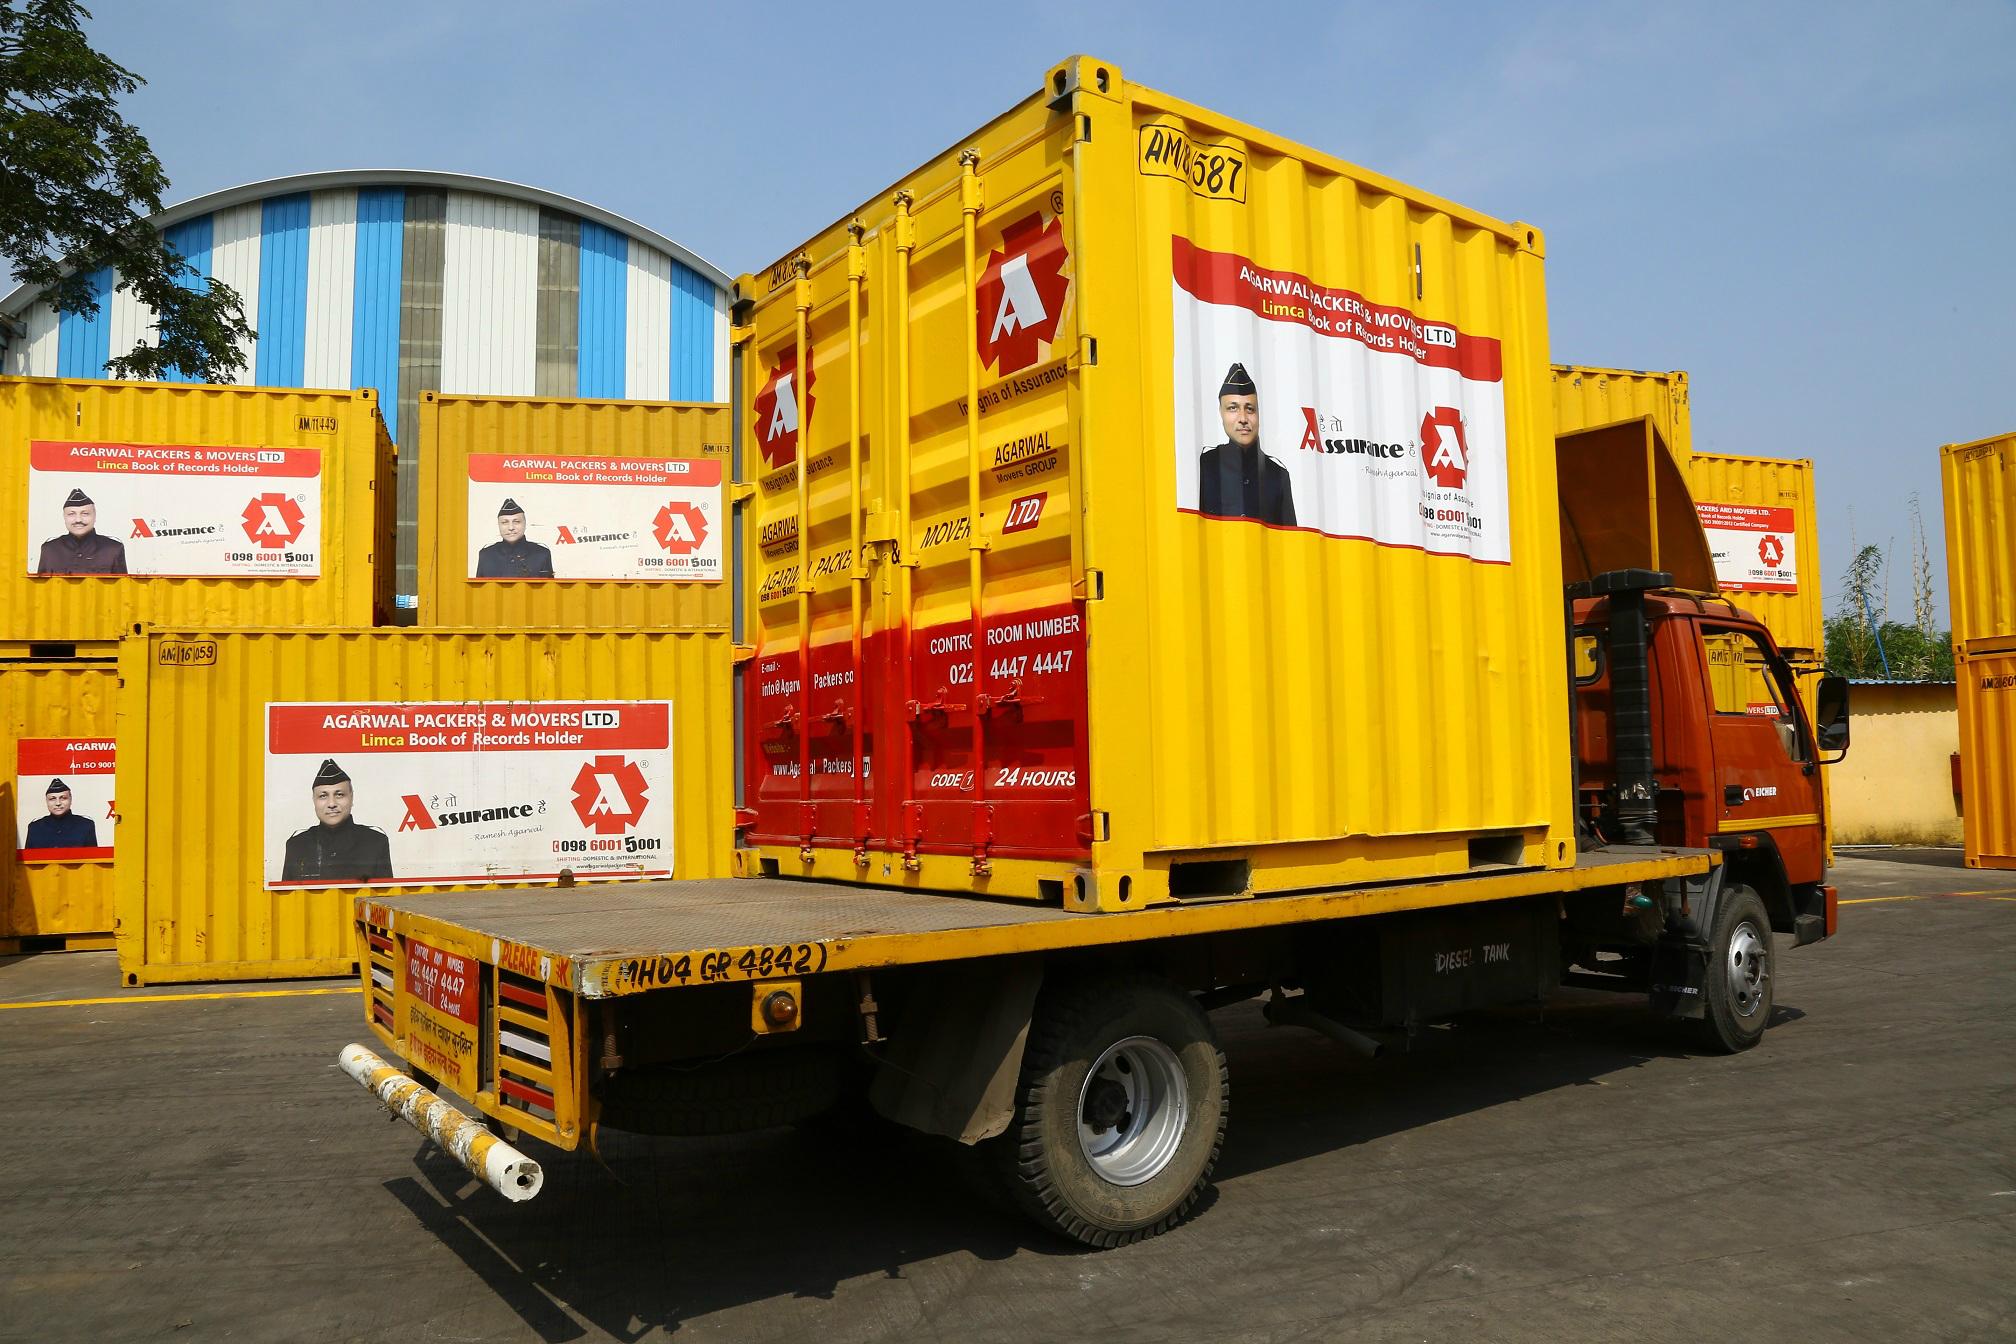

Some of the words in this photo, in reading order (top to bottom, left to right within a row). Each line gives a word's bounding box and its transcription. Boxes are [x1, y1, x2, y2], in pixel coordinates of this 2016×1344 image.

[1240, 266, 1310, 301] AGARWAL
[1310, 290, 1364, 318] PACKERS
[1365, 309, 1372, 323] &
[1375, 312, 1422, 340] MOVERS
[1426, 328, 1456, 346] LTD.
[1262, 299, 1304, 318] Limca
[1308, 309, 1330, 331] Book
[1335, 319, 1352, 333] of
[958, 390, 1001, 416] Ingnia
[1001, 383, 1012, 401] of
[1013, 364, 1068, 396] Assurance
[1299, 406, 1404, 458] Assurance
[70, 447, 134, 459] AGARWAL
[137, 449, 190, 460] PACKERS
[194, 450, 203, 460] &
[206, 450, 256, 461] MOVERS
[259, 452, 284, 463] LTD.
[994, 431, 1052, 466] AGARWAL
[97, 460, 128, 470] Limca
[131, 460, 160, 471] Book
[163, 461, 175, 471] of
[178, 461, 220, 473] Records
[223, 463, 259, 473] Holder
[503, 459, 558, 470] AGARWAL
[560, 460, 607, 470] PACKERS
[610, 461, 617, 471] &
[620, 462, 665, 472] MOVERS
[667, 463, 689, 472] LTD.
[995, 469, 1025, 484] Movers
[1025, 457, 1057, 477] GROUP
[525, 472, 553, 481] Limca
[556, 472, 580, 481] Book
[583, 472, 593, 482] of
[596, 473, 632, 483] Records
[636, 474, 667, 483] Holder
[1443, 492, 1452, 501] of
[1005, 498, 1040, 528] LTD.
[1437, 509, 1465, 524] 6001
[1696, 505, 1719, 513] ACKERS
[1733, 507, 1758, 515] MOVERS
[1758, 508, 1771, 516] LTD.
[130, 518, 216, 539] Assurance
[556, 525, 630, 545] Assurance
[232, 553, 253, 562] 098
[256, 552, 282, 562] 6001
[284, 551, 315, 563] 5001
[644, 558, 664, 567] 098
[666, 558, 689, 567] 6001
[691, 557, 717, 568] 5001
[1764, 569, 1777, 577] 6001
[930, 633, 973, 655] CONTRO
[987, 624, 1023, 646] ROOM
[1026, 614, 1080, 640] NUMBER
[949, 662, 974, 685] 022
[989, 655, 1028, 680] 4447
[1032, 649, 1073, 675] 4447
[814, 671, 843, 690] Packers
[1745, 706, 1764, 714] VERS
[322, 714, 409, 729] AGARWAL
[414, 713, 486, 728] PACKERS
[491, 713, 506, 727] &
[511, 712, 580, 728] MOVERS
[585, 713, 618, 727] LTD.
[66, 742, 116, 751] AGARWA
[361, 733, 404, 747] Limca
[409, 732, 447, 746] Book
[451, 732, 467, 746] of
[473, 731, 530, 746] Records
[534, 731, 584, 745] Holder
[930, 773, 963, 787] CODE
[993, 767, 1020, 787] 24
[1020, 770, 1076, 787] HOURS
[1755, 786, 1777, 797] EICHER
[398, 794, 533, 833] Assurance
[508, 824, 545, 837] Agarwal
[561, 840, 587, 852] 098
[590, 839, 622, 851] 6001
[624, 836, 661, 853] 5001
[501, 942, 538, 977] PLEASE
[1483, 943, 1510, 963] TANK
[700, 951, 731, 982] GR
[422, 964, 439, 985] 4447
[441, 972, 465, 997] 4447
